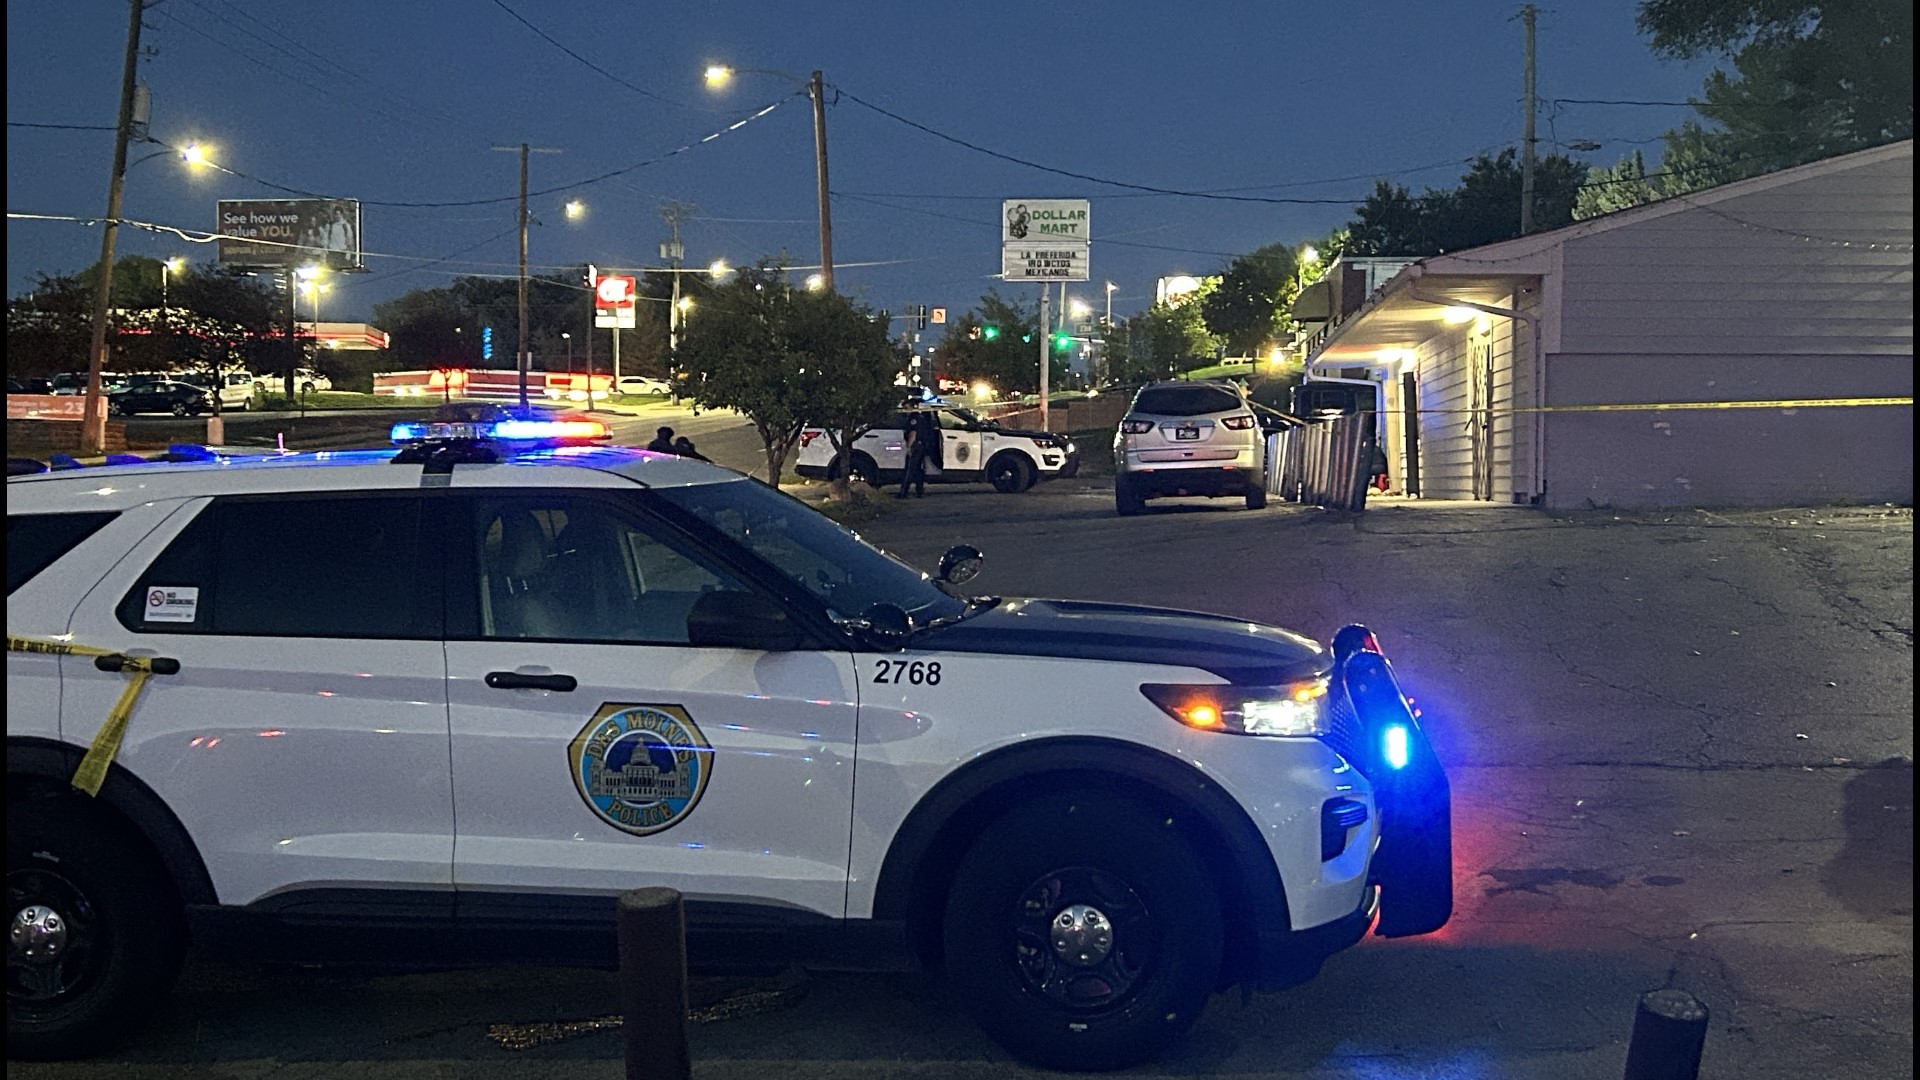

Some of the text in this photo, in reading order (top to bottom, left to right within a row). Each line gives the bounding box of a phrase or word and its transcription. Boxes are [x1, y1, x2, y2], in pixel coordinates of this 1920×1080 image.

[223, 211, 299, 224] See how we
[1032, 210, 1086, 220] DOLLAR
[224, 225, 294, 238] value YOU.
[1040, 223, 1078, 233] MART
[1020, 251, 1031, 259] LA
[873, 659, 942, 686] 2768
[586, 711, 695, 764] DES MOINES
[607, 800, 673, 826] POLICE
